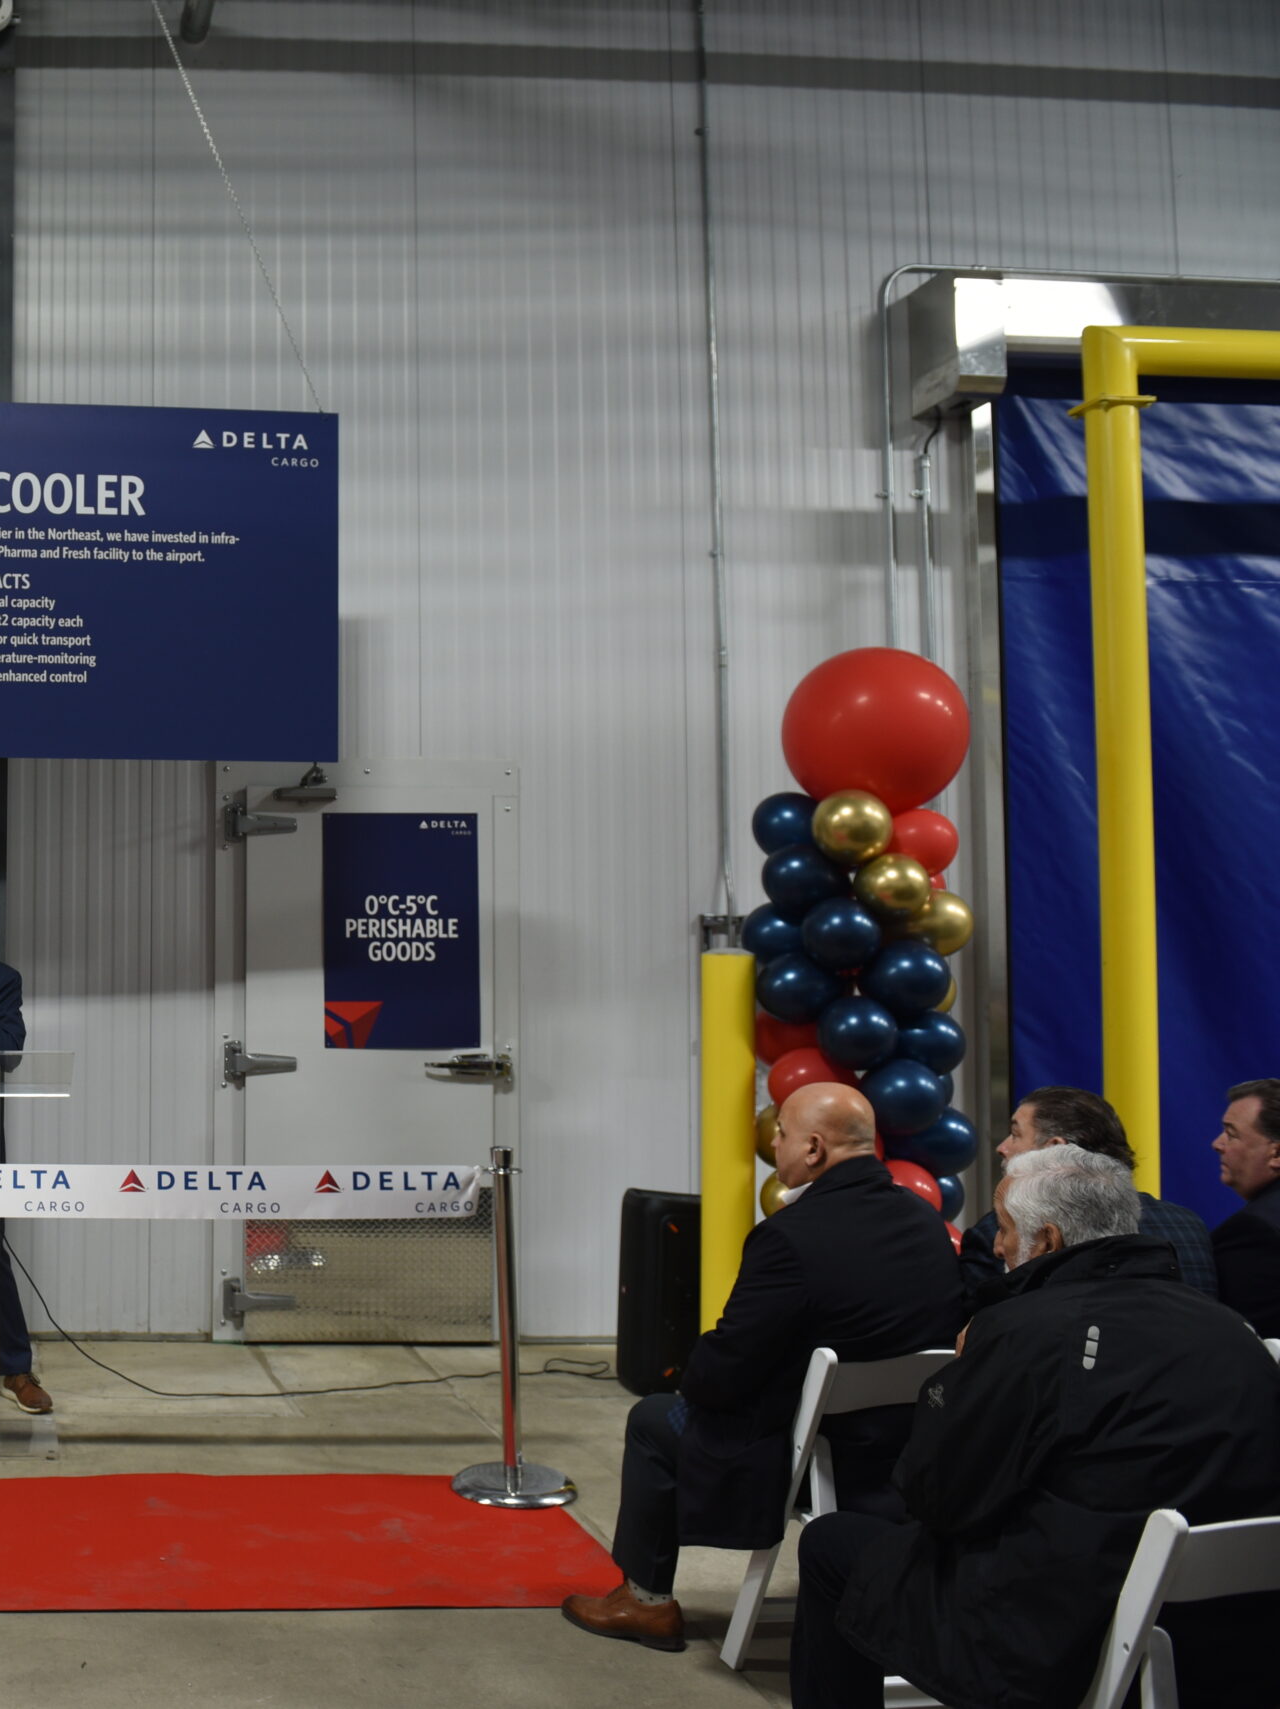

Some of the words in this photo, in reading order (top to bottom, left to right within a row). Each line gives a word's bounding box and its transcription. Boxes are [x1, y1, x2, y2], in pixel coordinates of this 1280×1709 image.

[222, 432, 308, 450] DELTA
[272, 458, 318, 468] CARGO
[15, 528, 25, 539] in
[27, 528, 45, 540] the
[48, 528, 104, 542] Northeast,
[106, 532, 122, 542] we
[124, 530, 150, 542] have
[152, 530, 196, 543] invested
[199, 532, 209, 544] in
[211, 532, 240, 544] infra-
[40, 546, 60, 559] and
[62, 547, 91, 559] Fresh
[93, 547, 130, 562] facility
[132, 549, 144, 560] to
[146, 548, 164, 561] the
[166, 550, 205, 564] airport.
[11, 596, 56, 611] capacity
[11, 615, 56, 629] capacity
[58, 615, 83, 627] each
[10, 633, 38, 647] quick
[41, 634, 91, 648] transport
[50, 671, 87, 683] control
[430, 820, 467, 829] DELTA
[365, 896, 438, 915] 0°C-5°C
[346, 918, 458, 938] PERISHABLE
[368, 942, 436, 962] GOODS
[157, 1171, 267, 1191] DELTA
[352, 1171, 460, 1192] DELTA
[24, 1202, 84, 1212] CARGO
[220, 1202, 281, 1214] CARGO
[414, 1201, 474, 1214] CARGO
